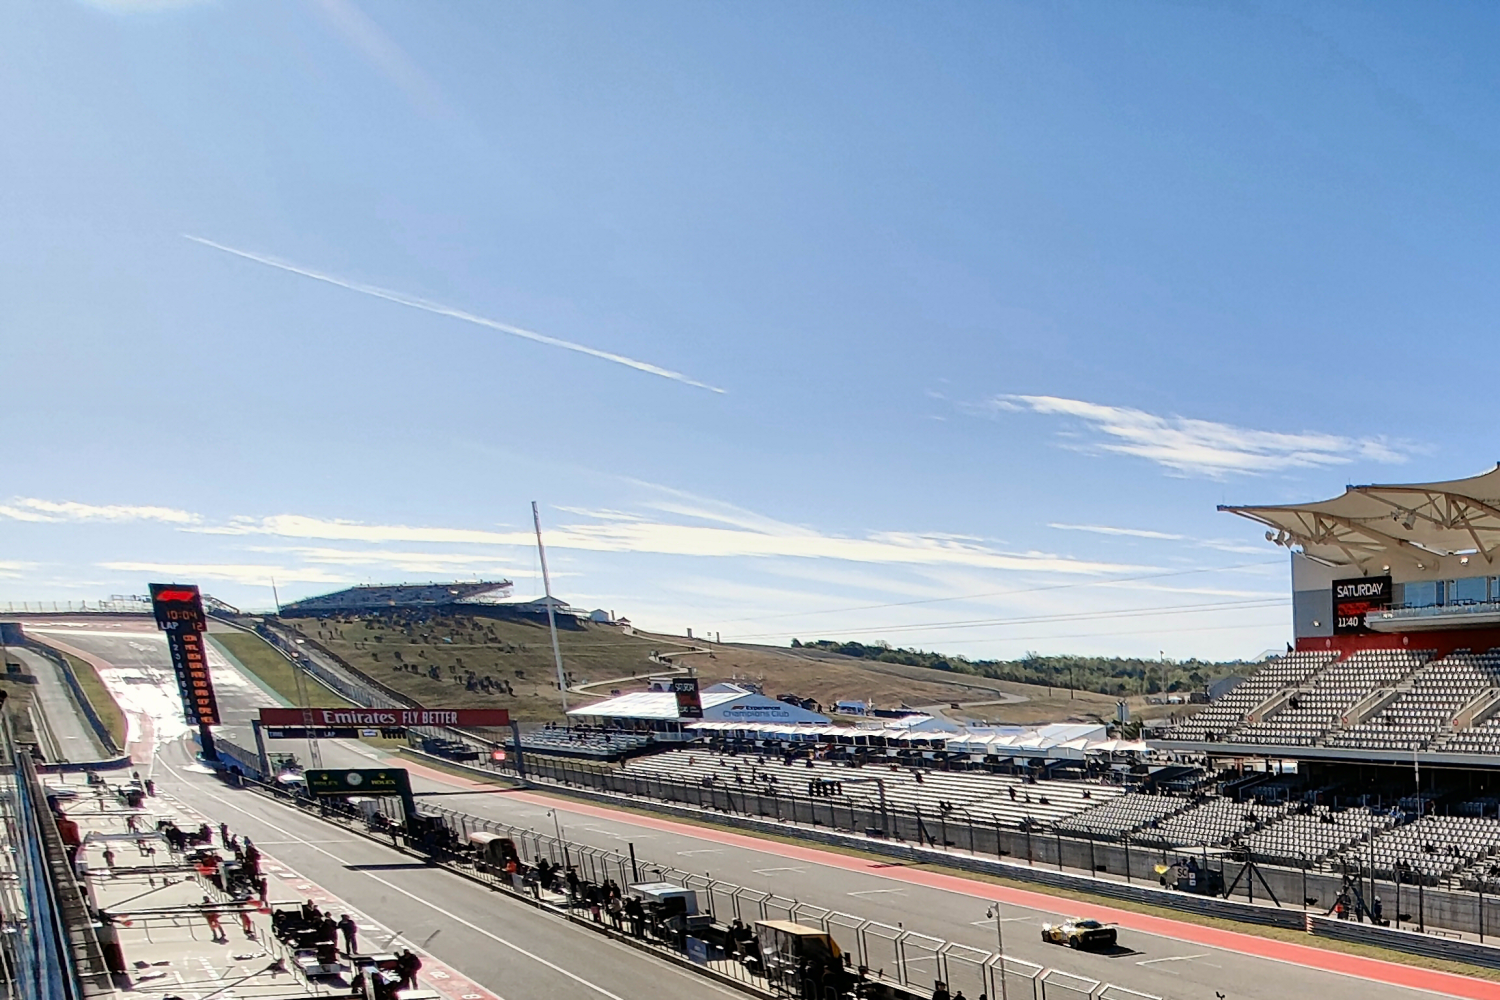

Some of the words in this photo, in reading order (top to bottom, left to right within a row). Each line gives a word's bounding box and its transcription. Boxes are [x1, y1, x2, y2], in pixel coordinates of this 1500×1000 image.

[1336, 582, 1384, 598] SATURDAY
[160, 621, 179, 630] LAP
[1338, 616, 1358, 628] 11:40
[323, 710, 396, 724] Emirates
[402, 711, 419, 724] FLY
[422, 711, 458, 724] BETTER
[1177, 867, 1188, 878] SC
